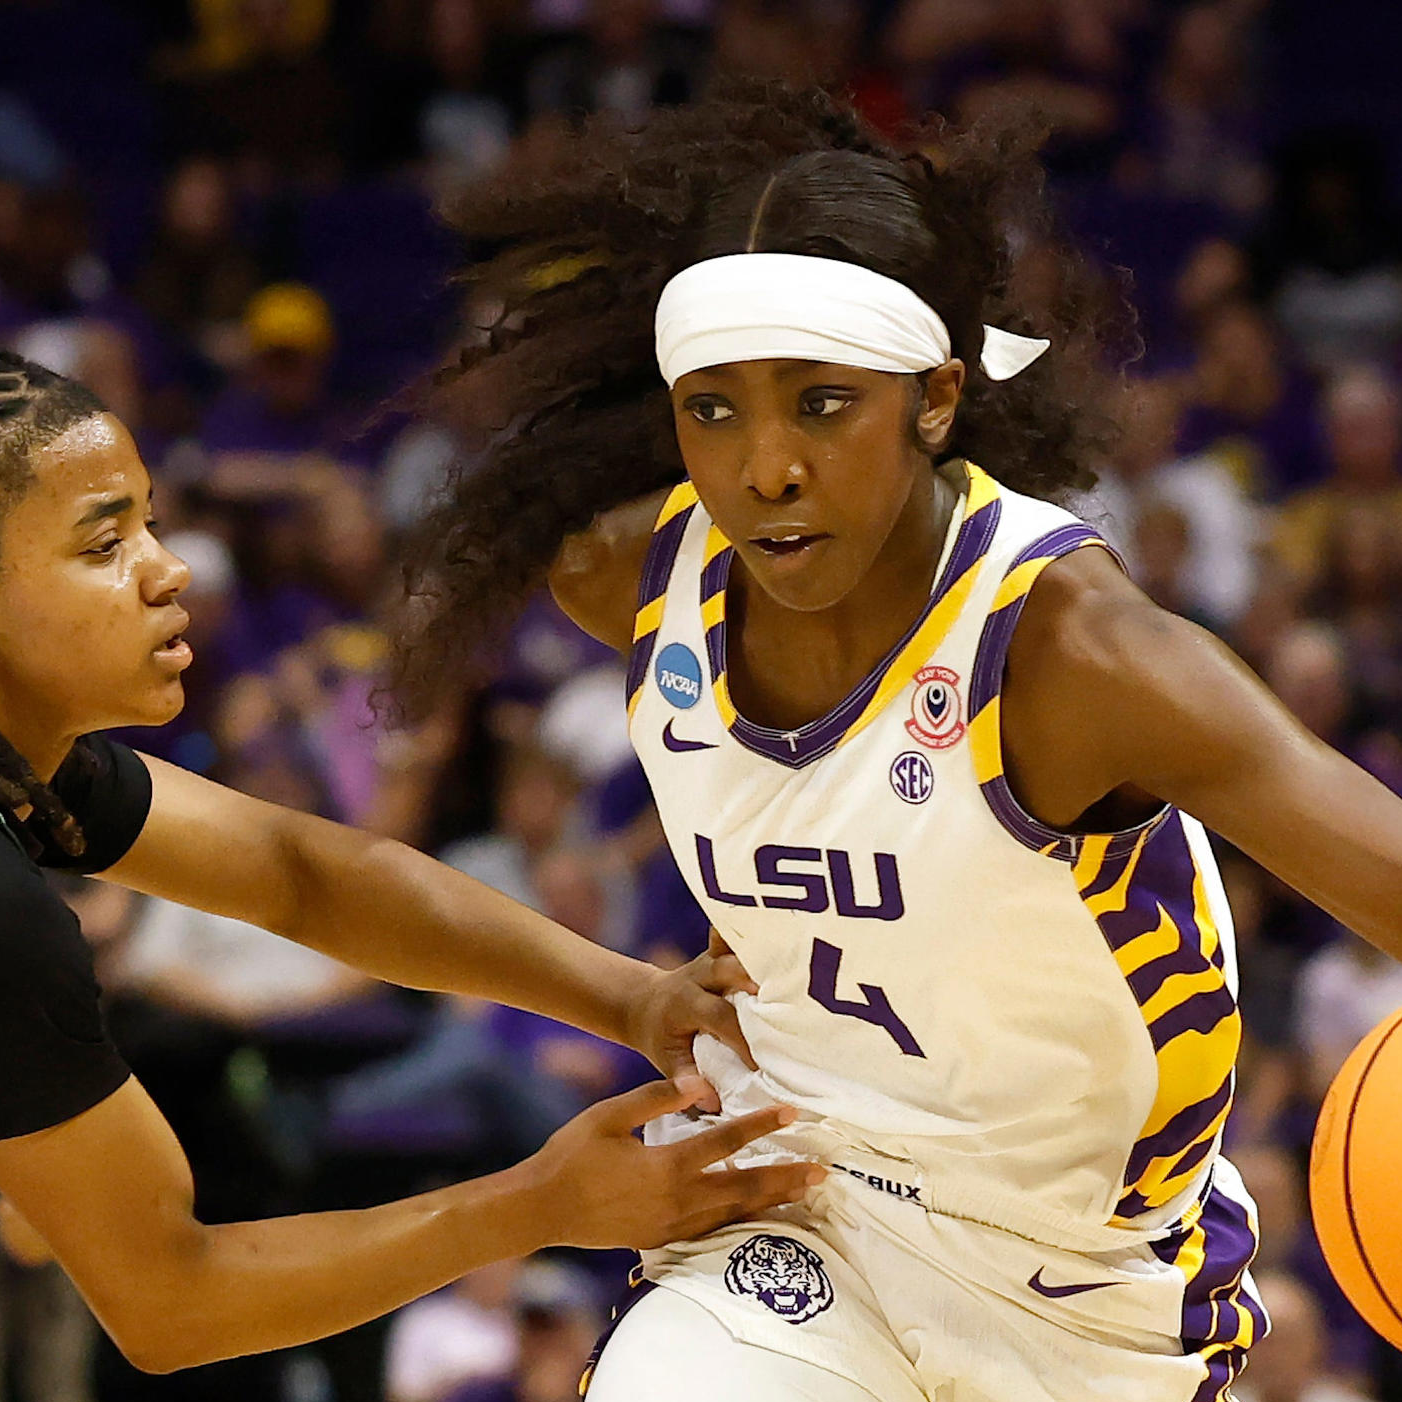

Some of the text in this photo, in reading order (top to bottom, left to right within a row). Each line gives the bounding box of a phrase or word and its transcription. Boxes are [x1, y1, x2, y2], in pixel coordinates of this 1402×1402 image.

[660, 669, 699, 699] NCAA
[895, 756, 929, 799] SEC
[694, 832, 905, 921] LSU
[807, 936, 928, 1059] 4
[830, 1163, 922, 1202] AUX
